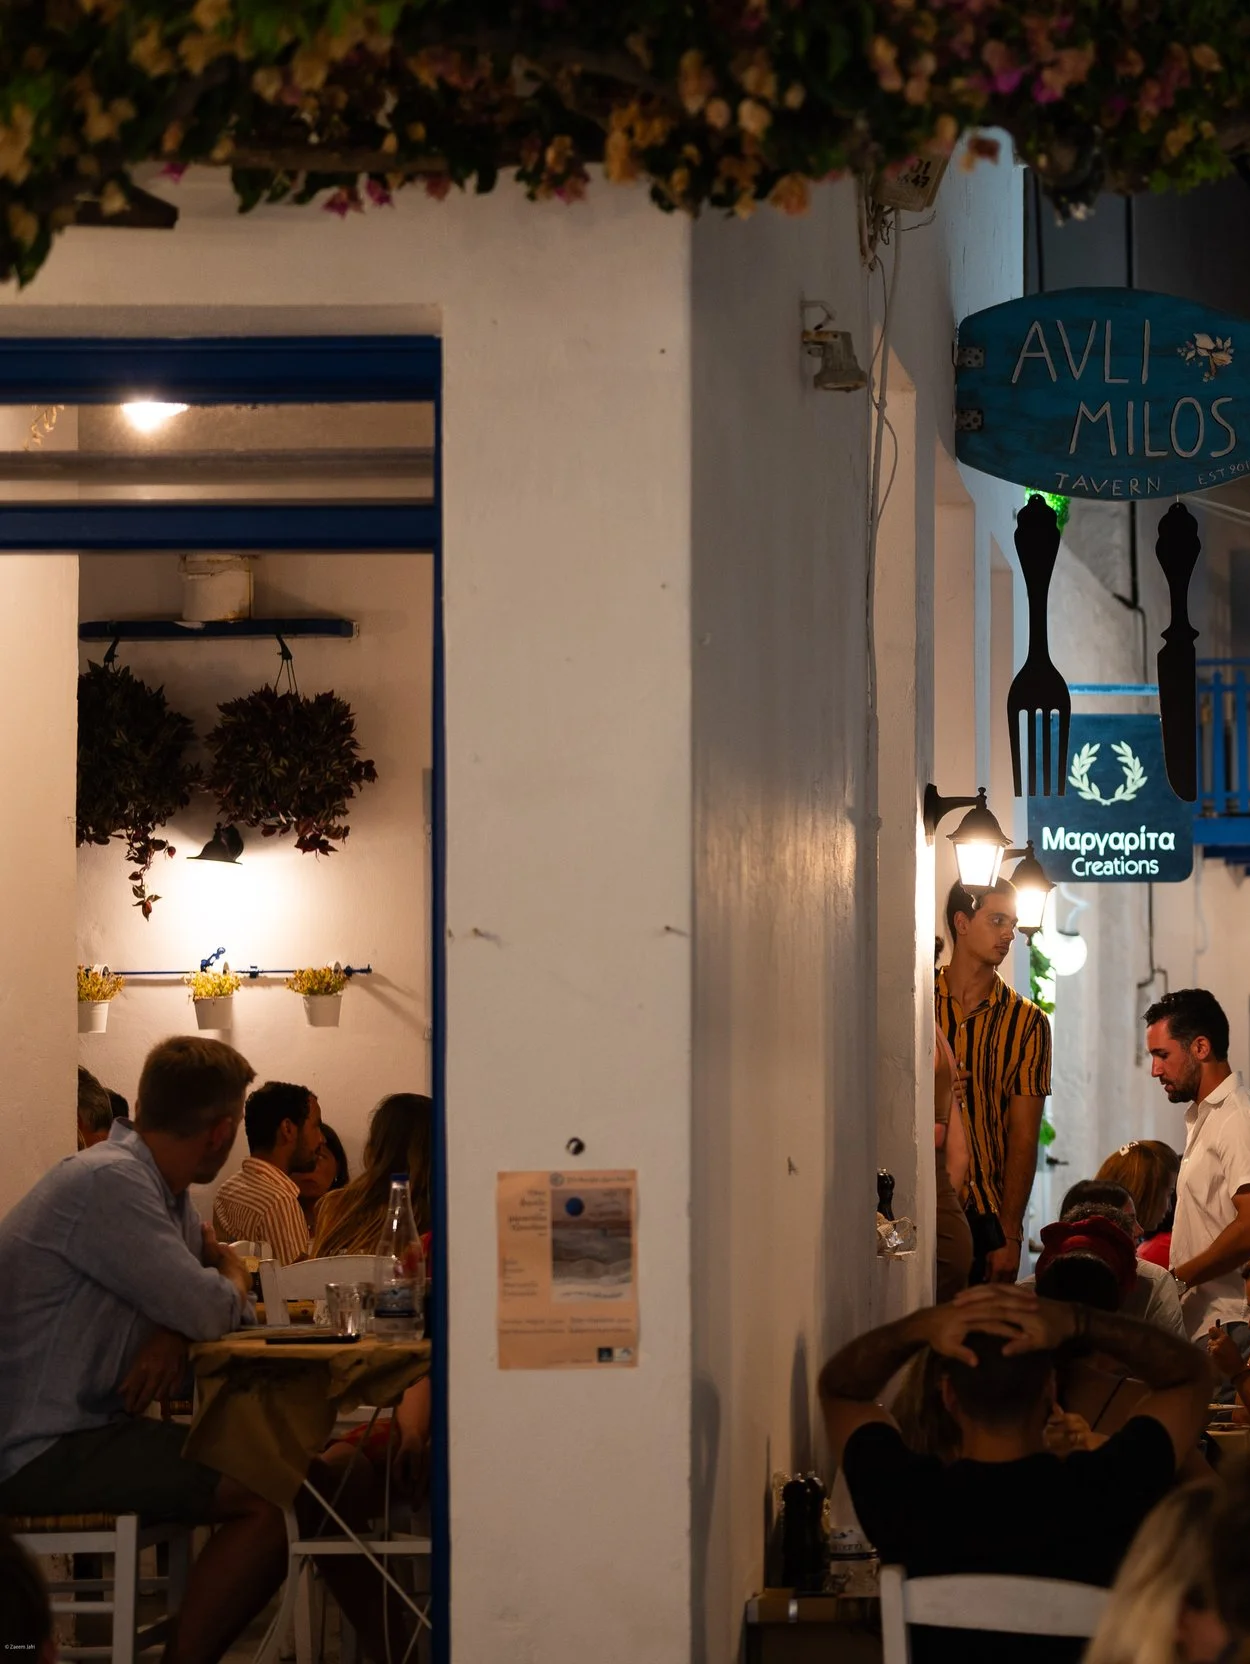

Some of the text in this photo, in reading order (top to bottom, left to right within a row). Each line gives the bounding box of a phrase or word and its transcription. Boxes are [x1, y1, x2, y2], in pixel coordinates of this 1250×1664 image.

[1011, 319, 1150, 384] AVLI
[1069, 396, 1237, 458] MILOS
[1055, 472, 1161, 496] TAVERN
[1197, 468, 1226, 486] EST
[1042, 825, 1175, 856] Μαργαρίτα
[1071, 856, 1159, 877] Creations
